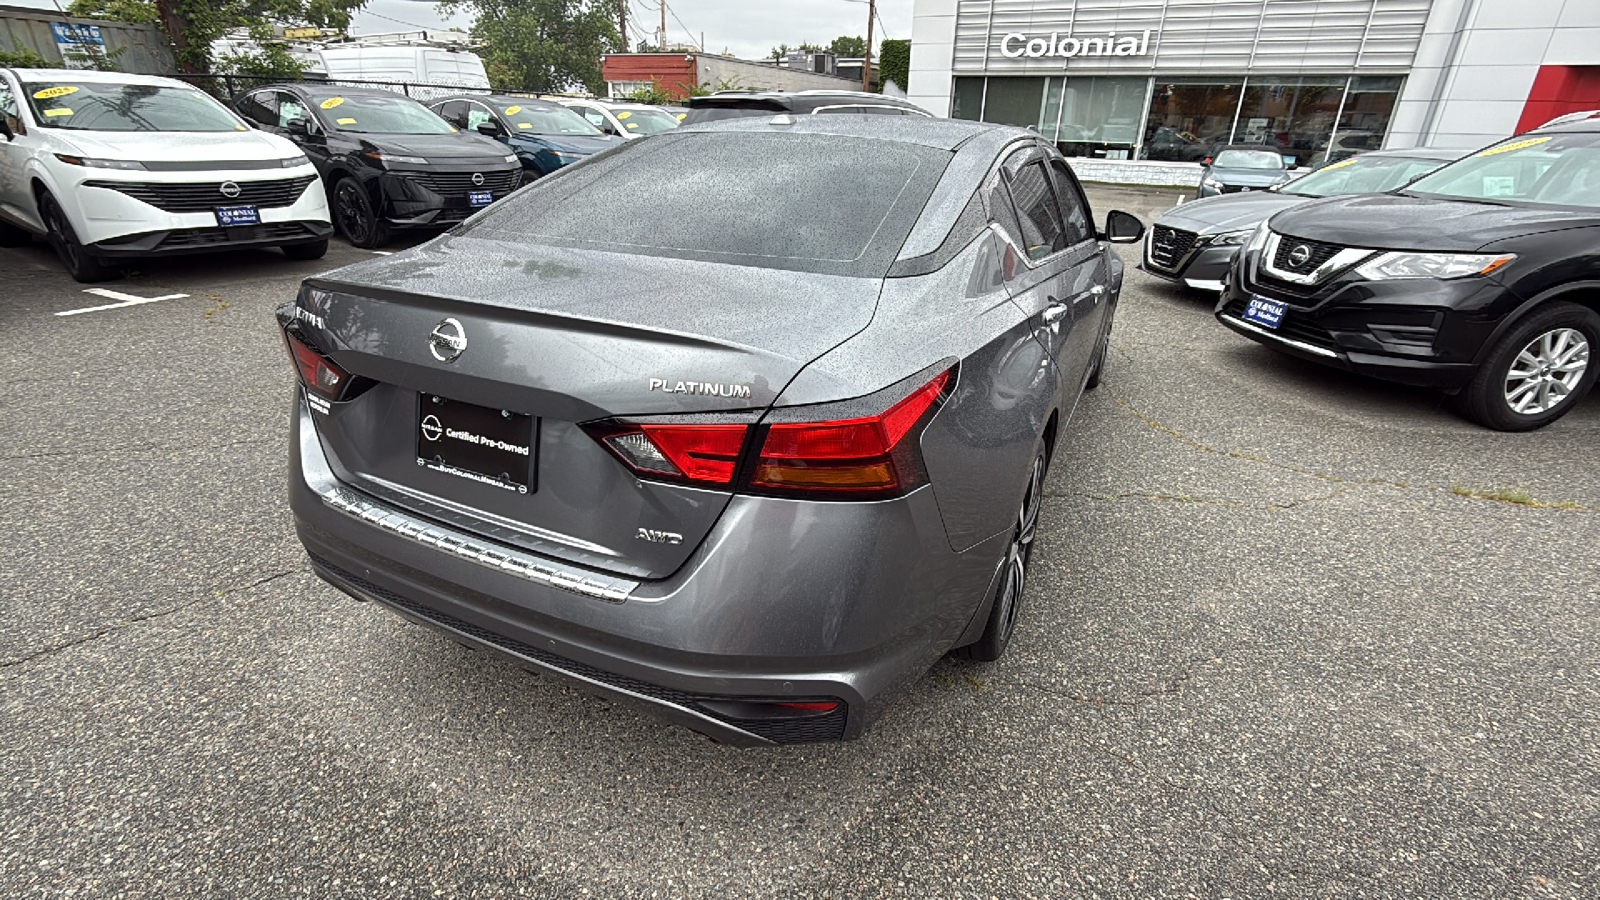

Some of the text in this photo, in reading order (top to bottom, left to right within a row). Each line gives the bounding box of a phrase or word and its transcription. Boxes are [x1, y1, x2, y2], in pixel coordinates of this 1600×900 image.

[1001, 29, 1150, 58] Colonial
[649, 377, 752, 399] PLATINUM
[421, 422, 443, 433] NISSAN
[446, 428, 530, 456] Certified Pre-Owned
[634, 527, 684, 545] AWD
